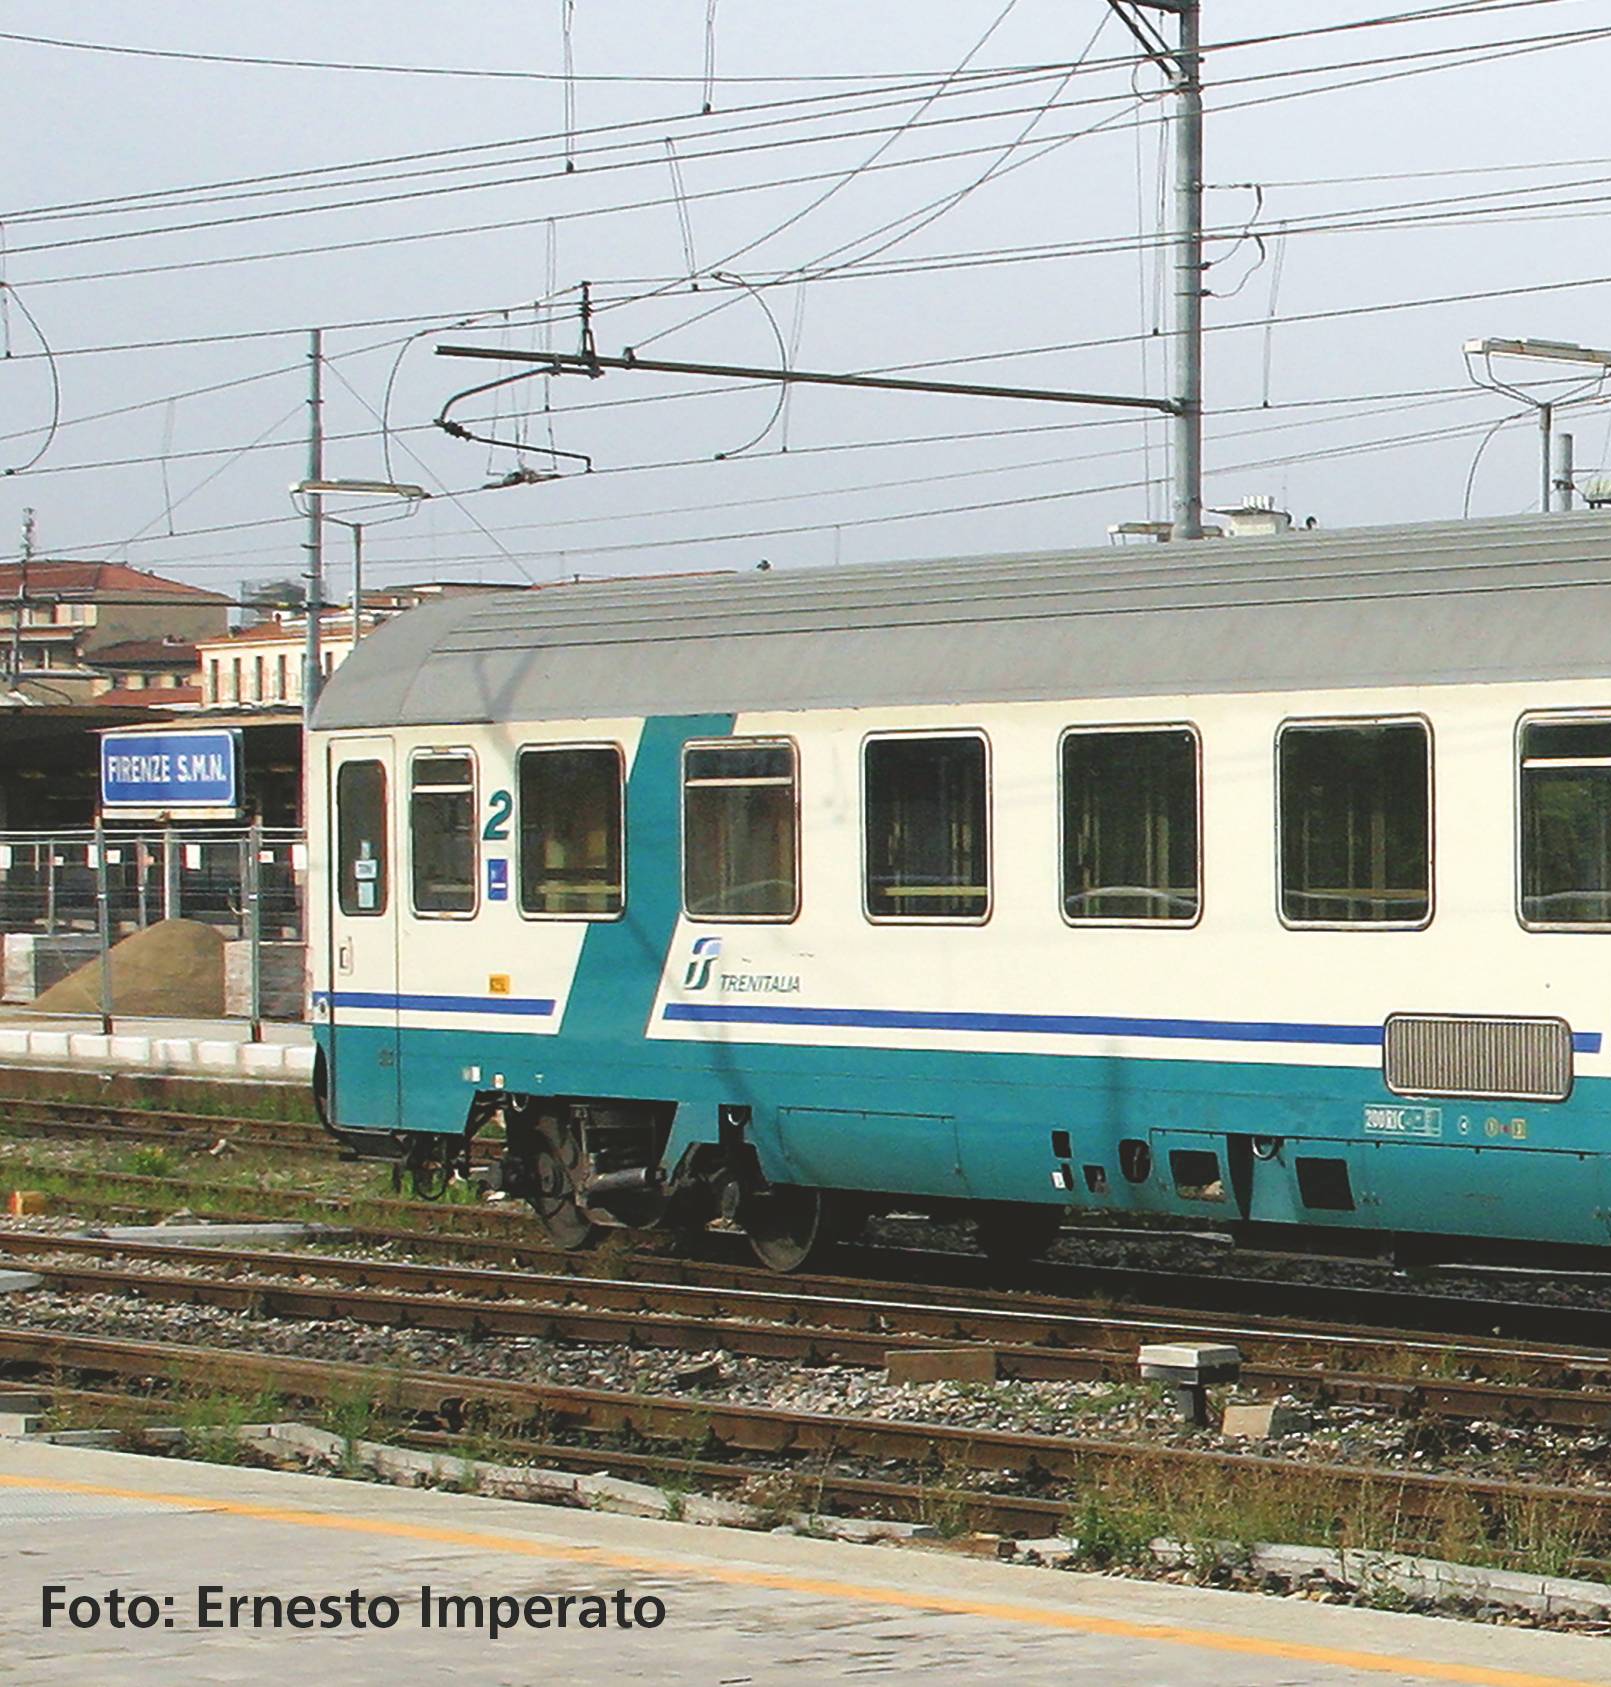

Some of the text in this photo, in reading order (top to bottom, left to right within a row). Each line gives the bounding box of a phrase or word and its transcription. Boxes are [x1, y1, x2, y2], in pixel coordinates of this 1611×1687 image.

[107, 753, 227, 782] FIRENZE S.M.N.
[482, 789, 513, 841] 2
[720, 974, 801, 993] TRENITALIA
